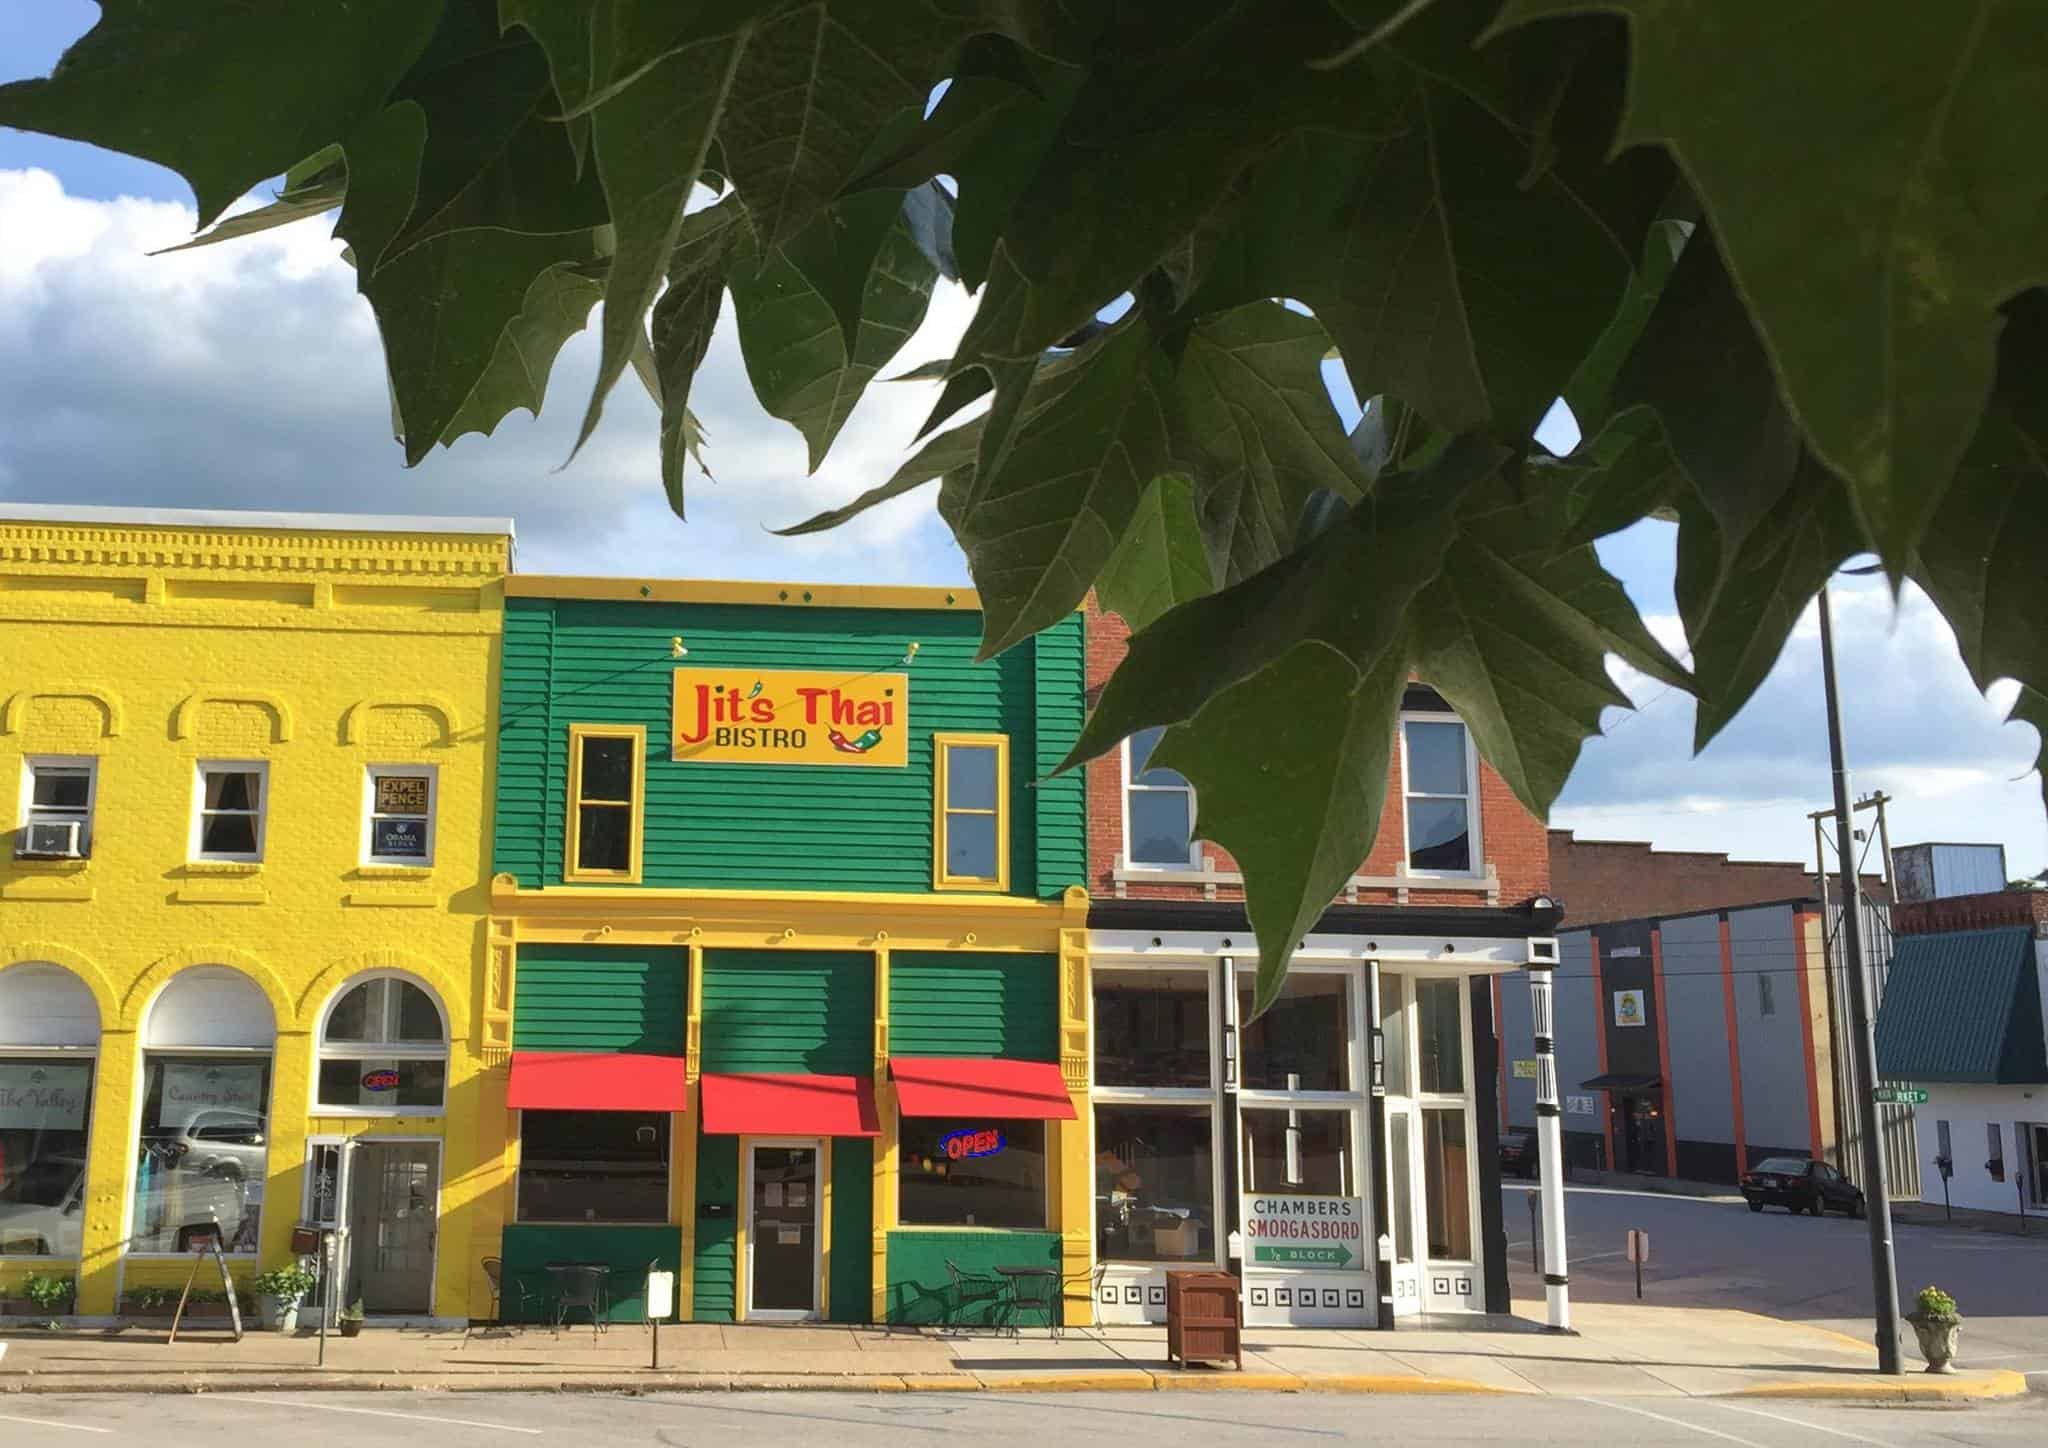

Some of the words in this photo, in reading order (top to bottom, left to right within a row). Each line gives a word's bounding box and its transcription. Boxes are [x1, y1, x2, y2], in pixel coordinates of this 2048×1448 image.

[681, 680, 775, 744] Jit's
[796, 687, 894, 726] Thai
[715, 727, 806, 749] BISTRO
[947, 1129, 999, 1160] OPEN
[1254, 1199, 1352, 1216] CHAMBERS
[1248, 1219, 1360, 1240] SMORGASBORD
[1288, 1250, 1335, 1260] BLOCK
